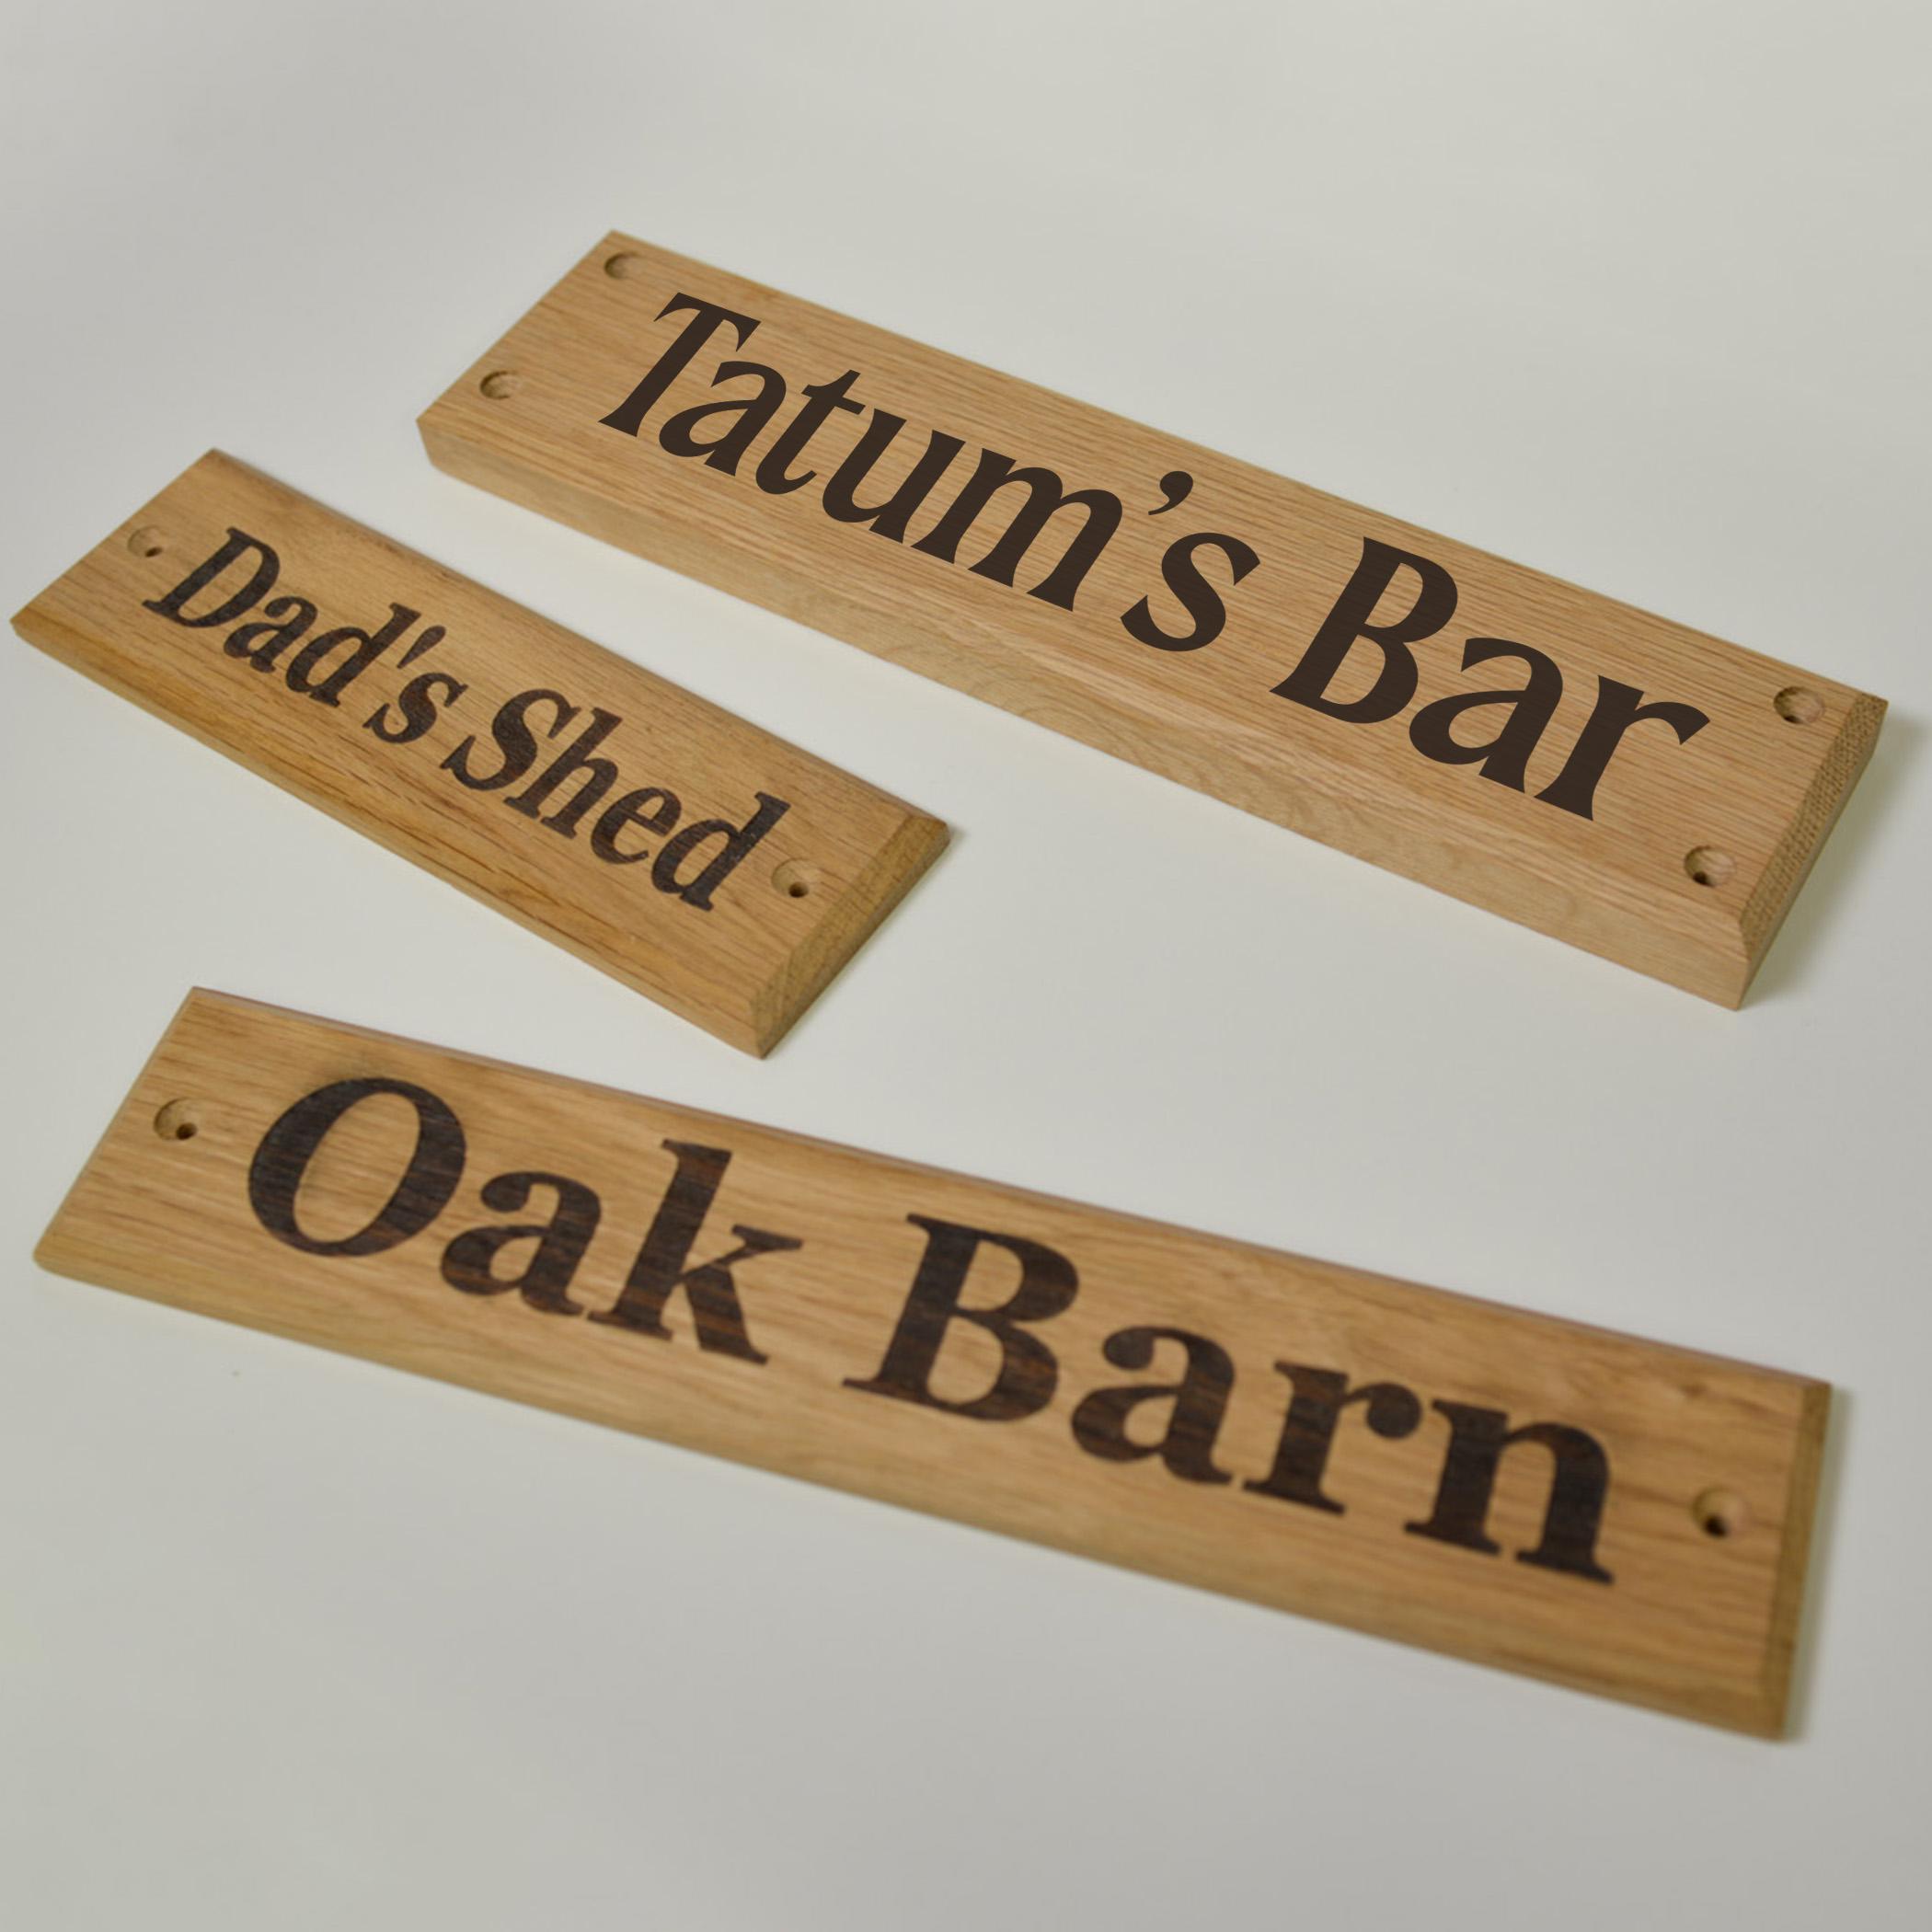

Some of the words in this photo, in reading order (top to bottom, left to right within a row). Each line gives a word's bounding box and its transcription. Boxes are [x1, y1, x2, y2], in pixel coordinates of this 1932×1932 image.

[140, 526, 469, 745] Dad's
[438, 688, 792, 913] Shed
[598, 292, 1260, 652] Tatum’s
[1269, 536, 1711, 822] Bar
[246, 1075, 804, 1367] Oak
[841, 1212, 1617, 1589] Barn
